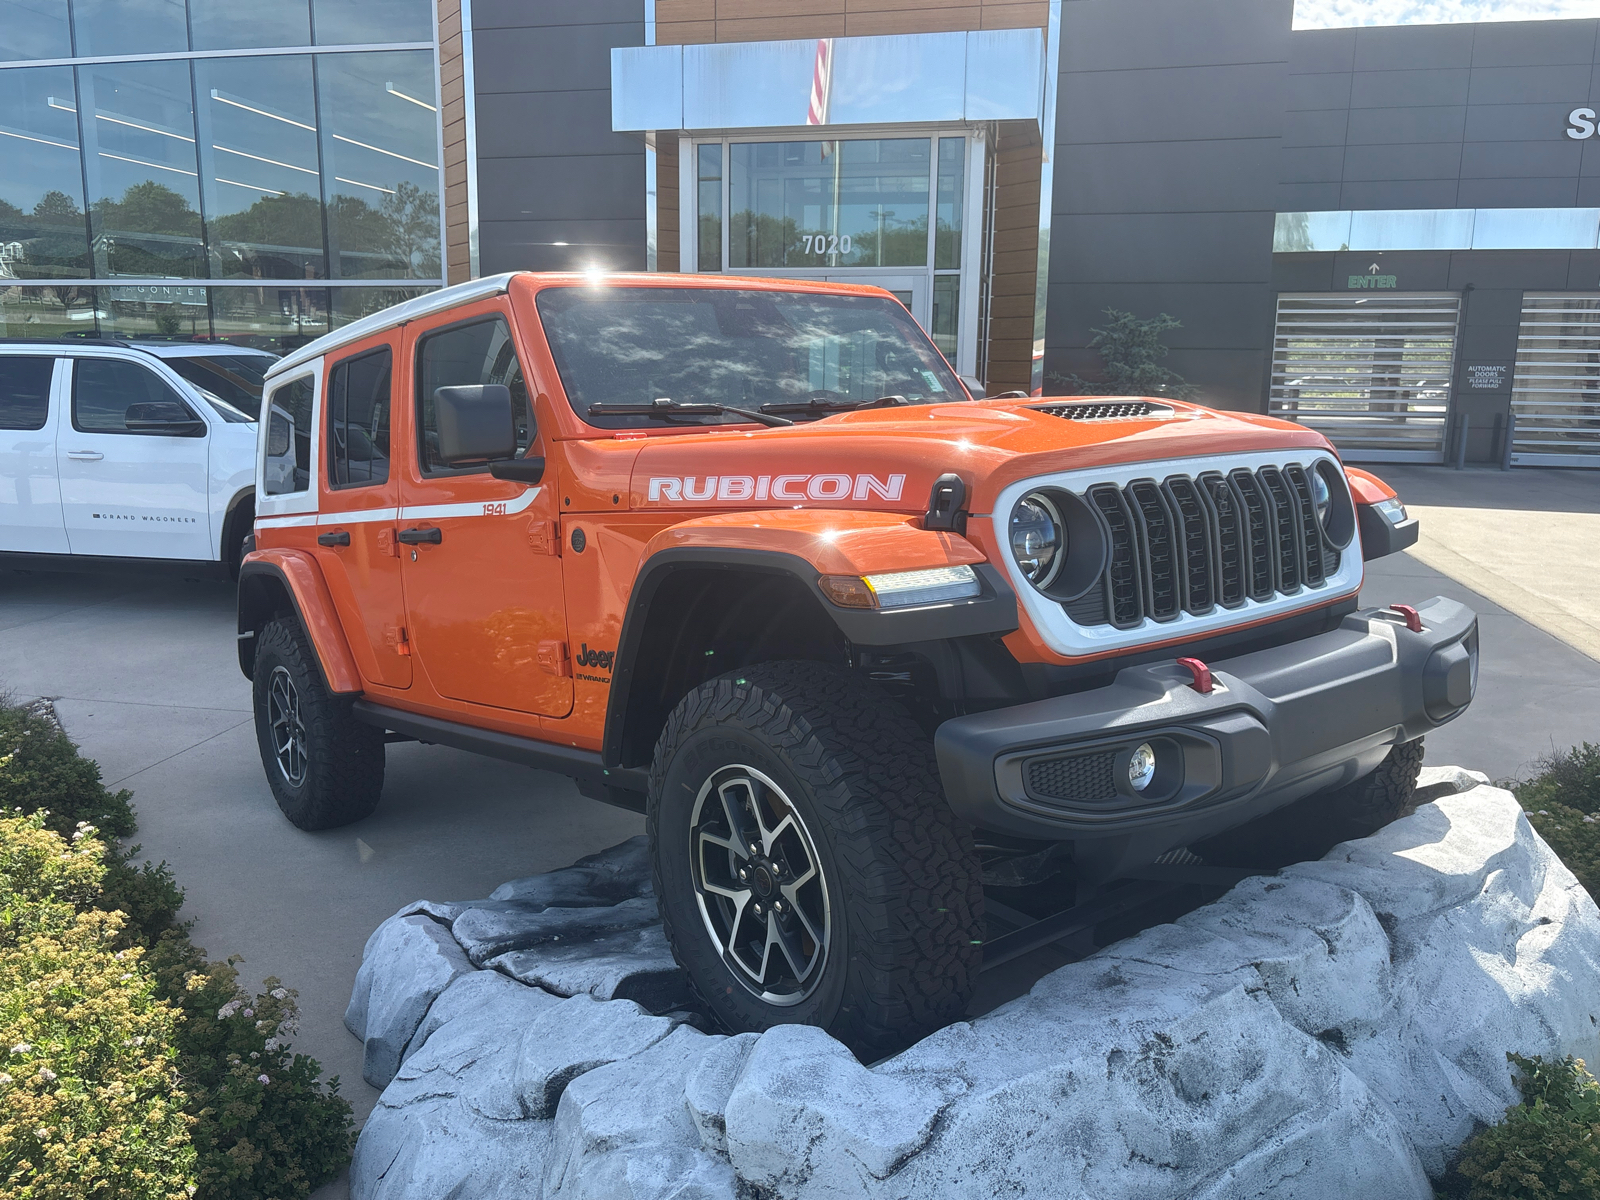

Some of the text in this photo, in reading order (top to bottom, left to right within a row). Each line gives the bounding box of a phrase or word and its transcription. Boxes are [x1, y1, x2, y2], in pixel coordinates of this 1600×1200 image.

[1566, 107, 1600, 140] S
[802, 234, 851, 254] 7020
[1347, 274, 1397, 289] ENTER
[648, 473, 906, 501] RUBICON
[482, 502, 507, 516] 1941
[102, 513, 196, 523] GRAND WAGONEER
[583, 674, 611, 683] WRANG
